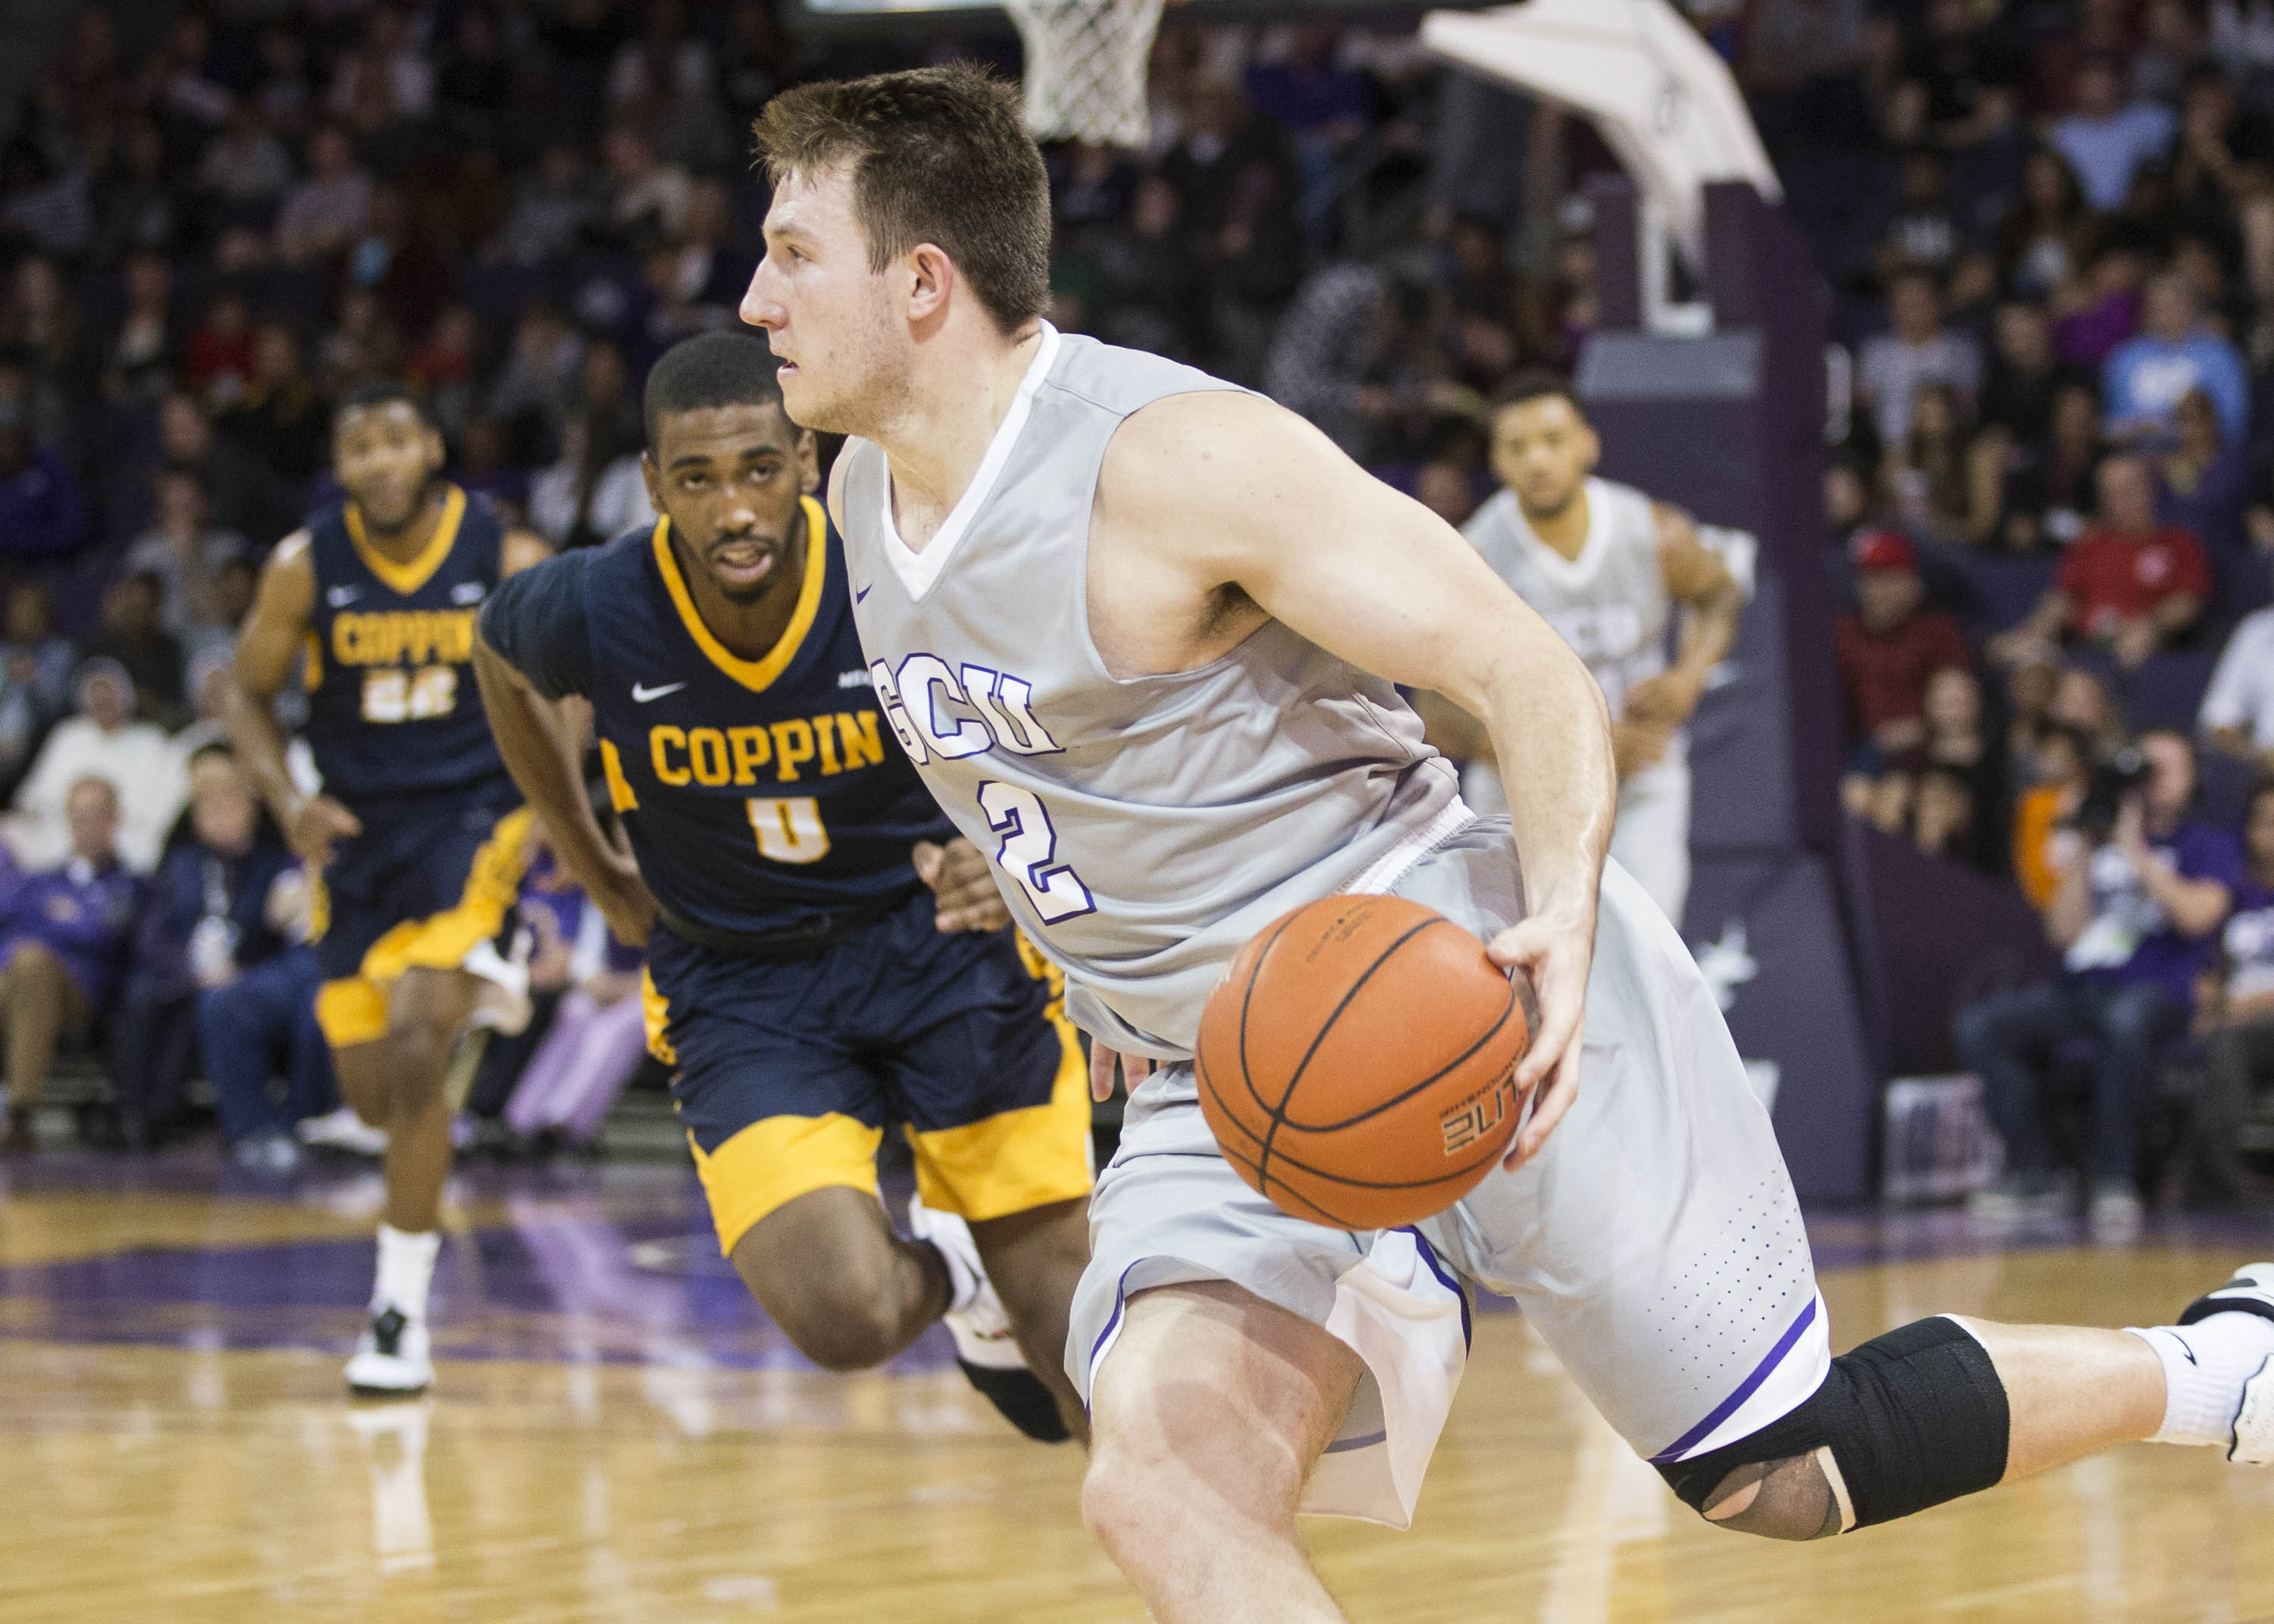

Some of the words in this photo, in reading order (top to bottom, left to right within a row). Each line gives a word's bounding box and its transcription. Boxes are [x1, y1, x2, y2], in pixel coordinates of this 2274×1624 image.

[649, 710, 885, 787] COPPIN
[871, 652, 1067, 766] GCU
[746, 796, 832, 865] 0
[976, 779, 1098, 926] 2
[1442, 1073, 1521, 1156] LITE
